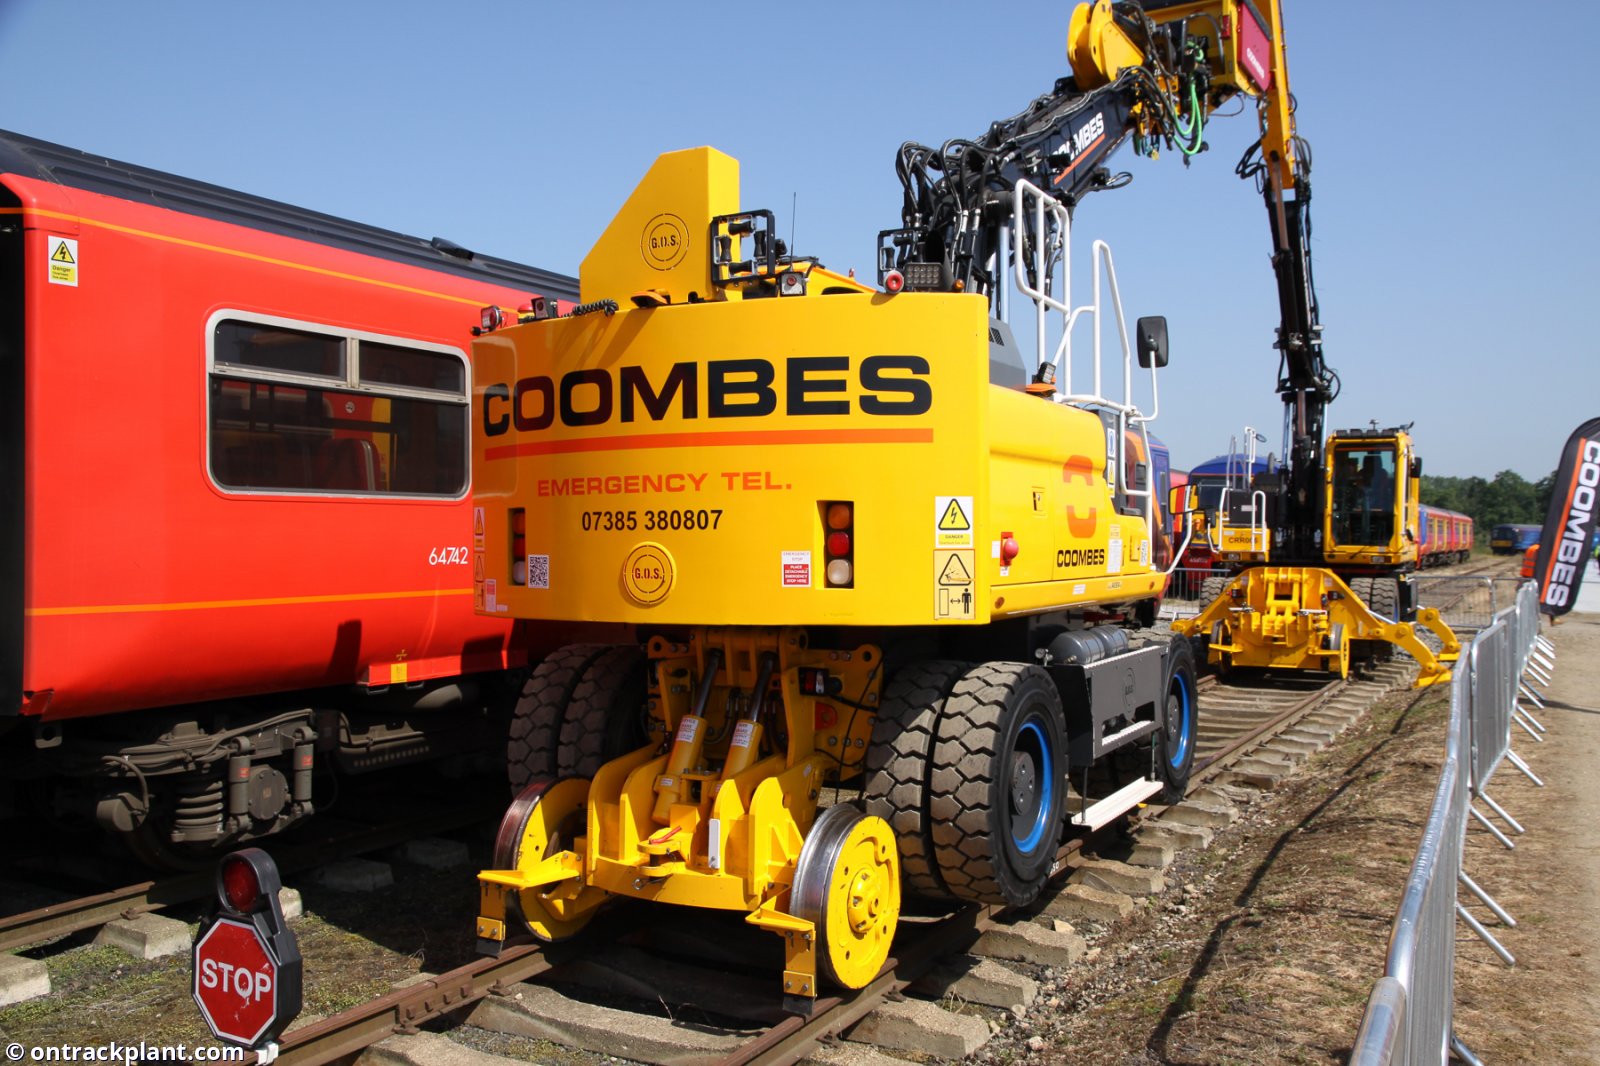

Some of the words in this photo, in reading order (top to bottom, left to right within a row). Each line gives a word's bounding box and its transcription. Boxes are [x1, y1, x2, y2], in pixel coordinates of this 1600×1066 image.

[1050, 112, 1104, 161] MBES
[484, 355, 932, 438] COOMBES
[537, 473, 708, 498] EMERGENCY
[721, 471, 792, 491] TEL.
[581, 511, 637, 532] 07385
[644, 509, 723, 531] 380807
[1546, 440, 1600, 607] COOMBES
[429, 546, 468, 565] 64742
[1057, 549, 1105, 568] COOMBES
[201, 959, 272, 1002] STOP
